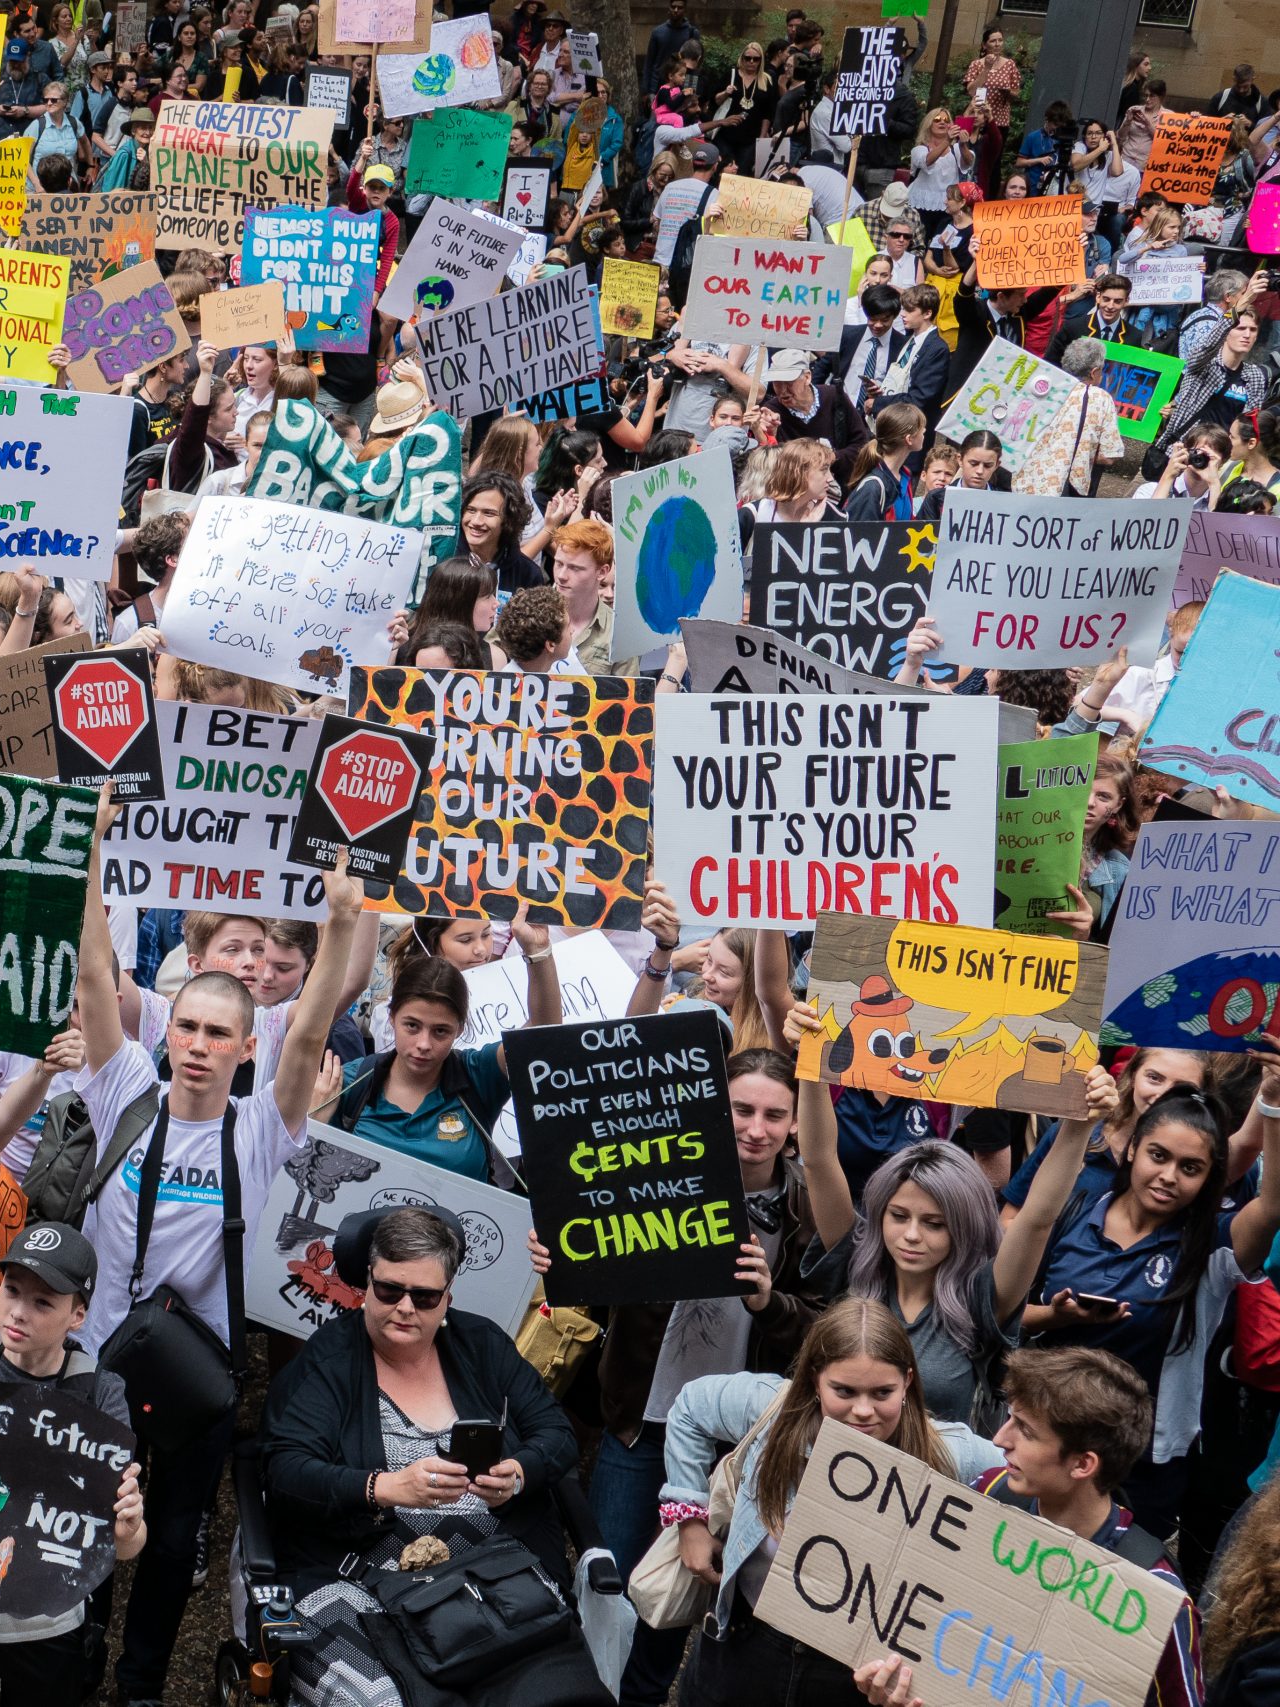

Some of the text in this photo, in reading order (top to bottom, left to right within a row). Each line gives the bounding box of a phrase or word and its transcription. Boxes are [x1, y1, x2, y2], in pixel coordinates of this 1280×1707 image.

[574, 49, 594, 58] TREES
[859, 28, 896, 55] THE
[839, 55, 901, 88] STUDENTS
[836, 87, 895, 101] ARE GOING TO
[164, 103, 300, 138] THE GREATEST
[833, 102, 887, 134] WAR
[1159, 114, 1233, 132] Look Around
[160, 125, 324, 177] THREAT TO OUR
[1156, 127, 1228, 145] The Youth Are
[156, 150, 321, 202] PLANET IS THE
[438, 215, 509, 255] OUR FUTURE
[979, 222, 1081, 246] GO TO SCHOOL
[435, 258, 471, 280] HANDS
[733, 247, 826, 275] I WANT
[982, 255, 1079, 273] LISTEN TO THE
[995, 268, 1075, 286] EDUCATED
[704, 275, 840, 306] OUR EARTH
[416, 316, 478, 358] WE'RE
[485, 273, 588, 336] LEARNING
[727, 307, 824, 338] TO LIVE!
[425, 306, 591, 394] FOR A FUTURE
[40, 393, 81, 416] THE
[948, 558, 1158, 600] ARE YOU LEAVING
[972, 611, 1127, 650] FOR US?
[70, 680, 130, 705] #STOP
[76, 704, 132, 729] ADANI
[710, 700, 930, 751] THIS ISN'T
[340, 748, 405, 782] #STOP
[673, 752, 957, 811] YOUR FUTURE
[333, 773, 396, 807] ADANI
[731, 813, 917, 860] IT'S YOUR
[896, 939, 1077, 995] THIS ISN'T FINE
[581, 1023, 643, 1051] OUR
[591, 1109, 682, 1138] ENOUGH
[580, 1176, 704, 1208] TO MAKE
[560, 1200, 736, 1262] CHANGE
[30, 1409, 132, 1472] future
[25, 1501, 109, 1548] NOT
[828, 1451, 1148, 1635] ONE WORLD
[793, 1534, 944, 1662] ONE
